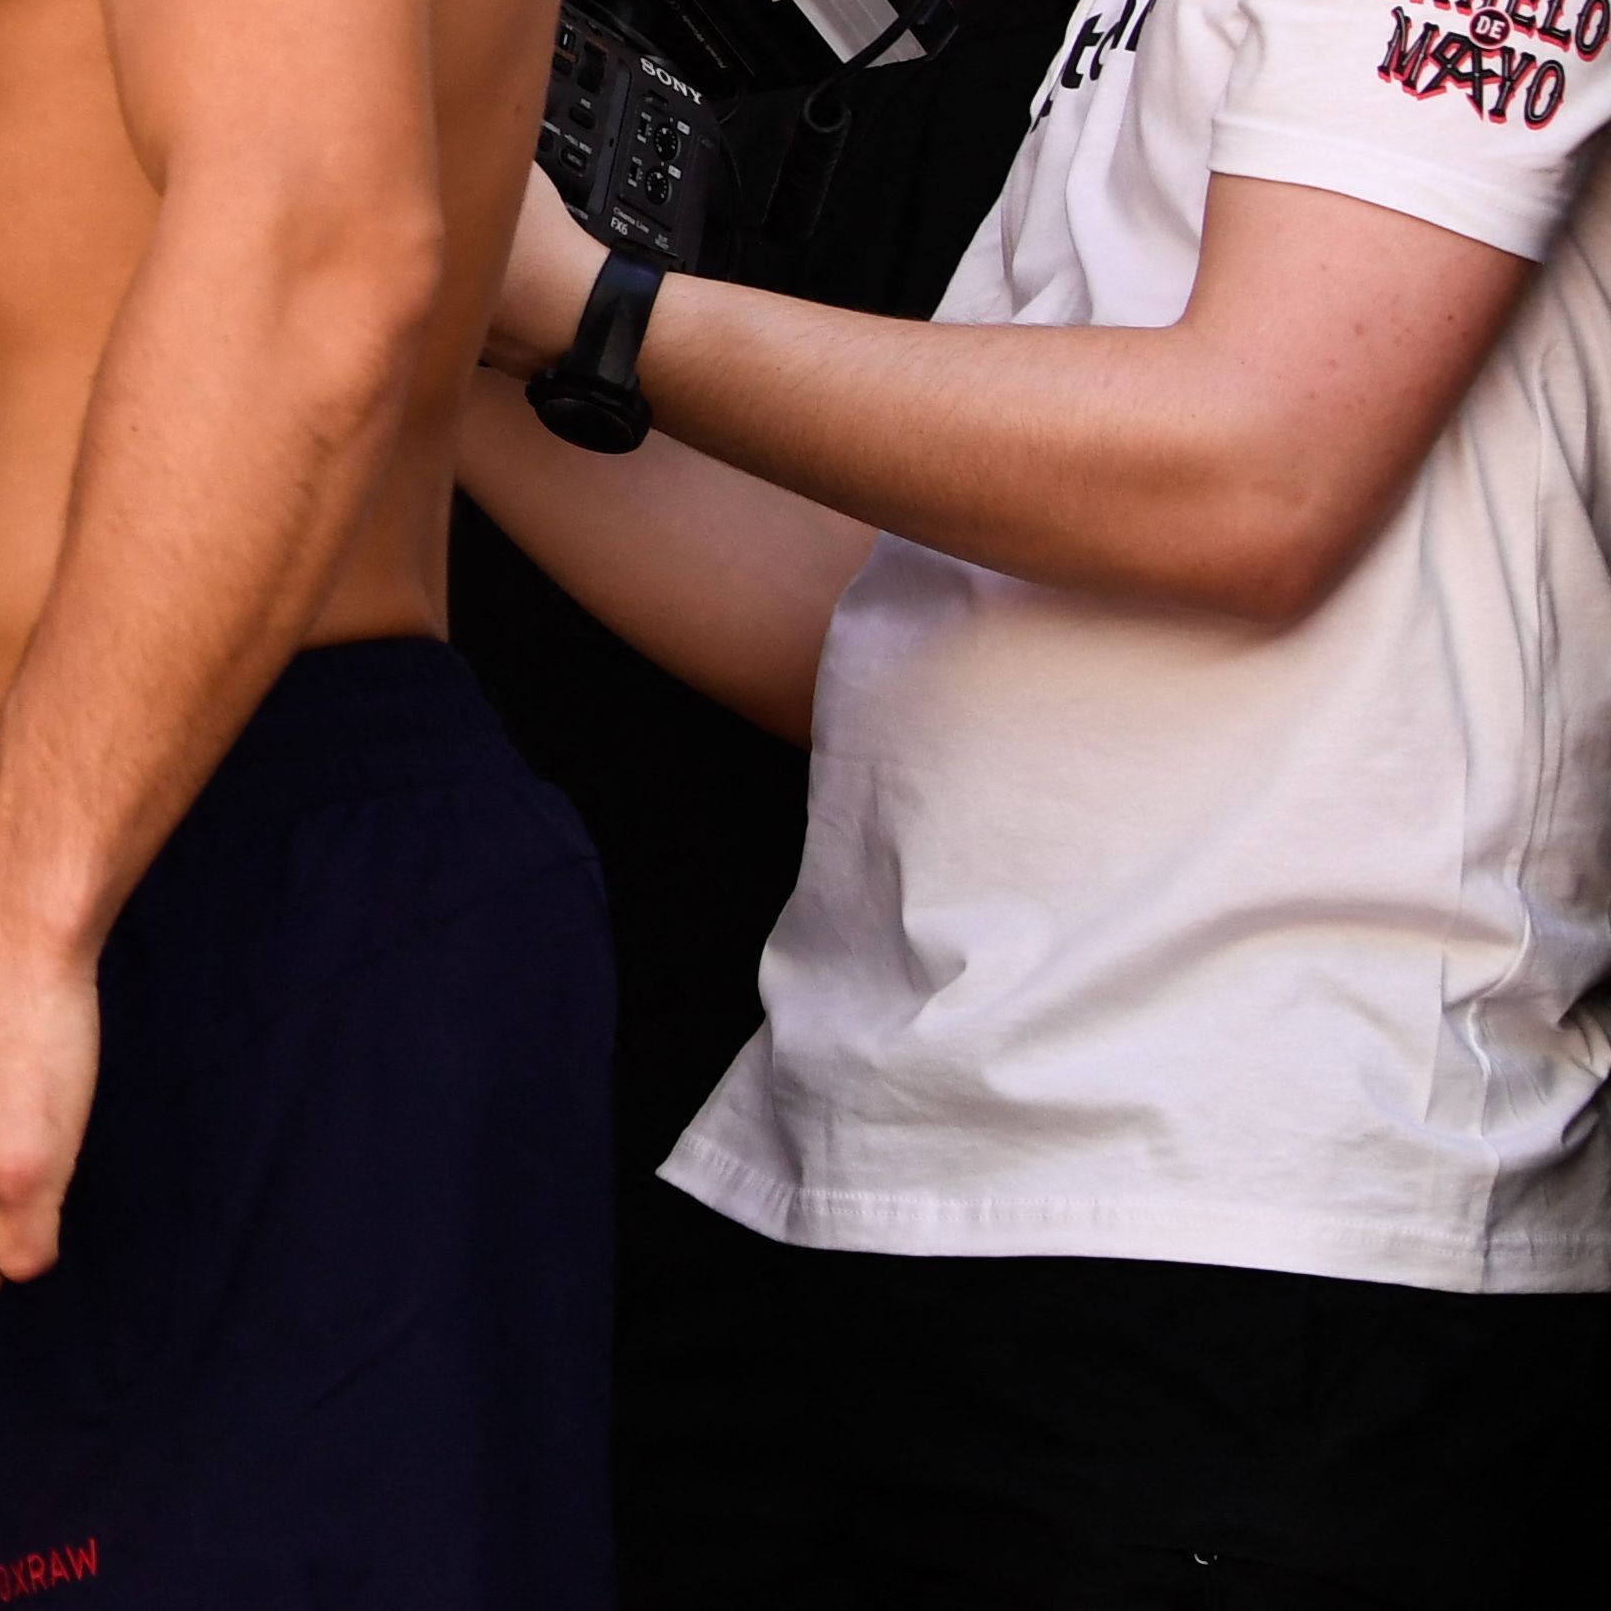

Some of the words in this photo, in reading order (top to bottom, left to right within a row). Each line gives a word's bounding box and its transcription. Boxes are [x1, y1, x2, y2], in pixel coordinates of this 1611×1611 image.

[1475, 16, 1506, 40] DE
[640, 57, 703, 105] SONY
[610, 216, 629, 236] FX6
